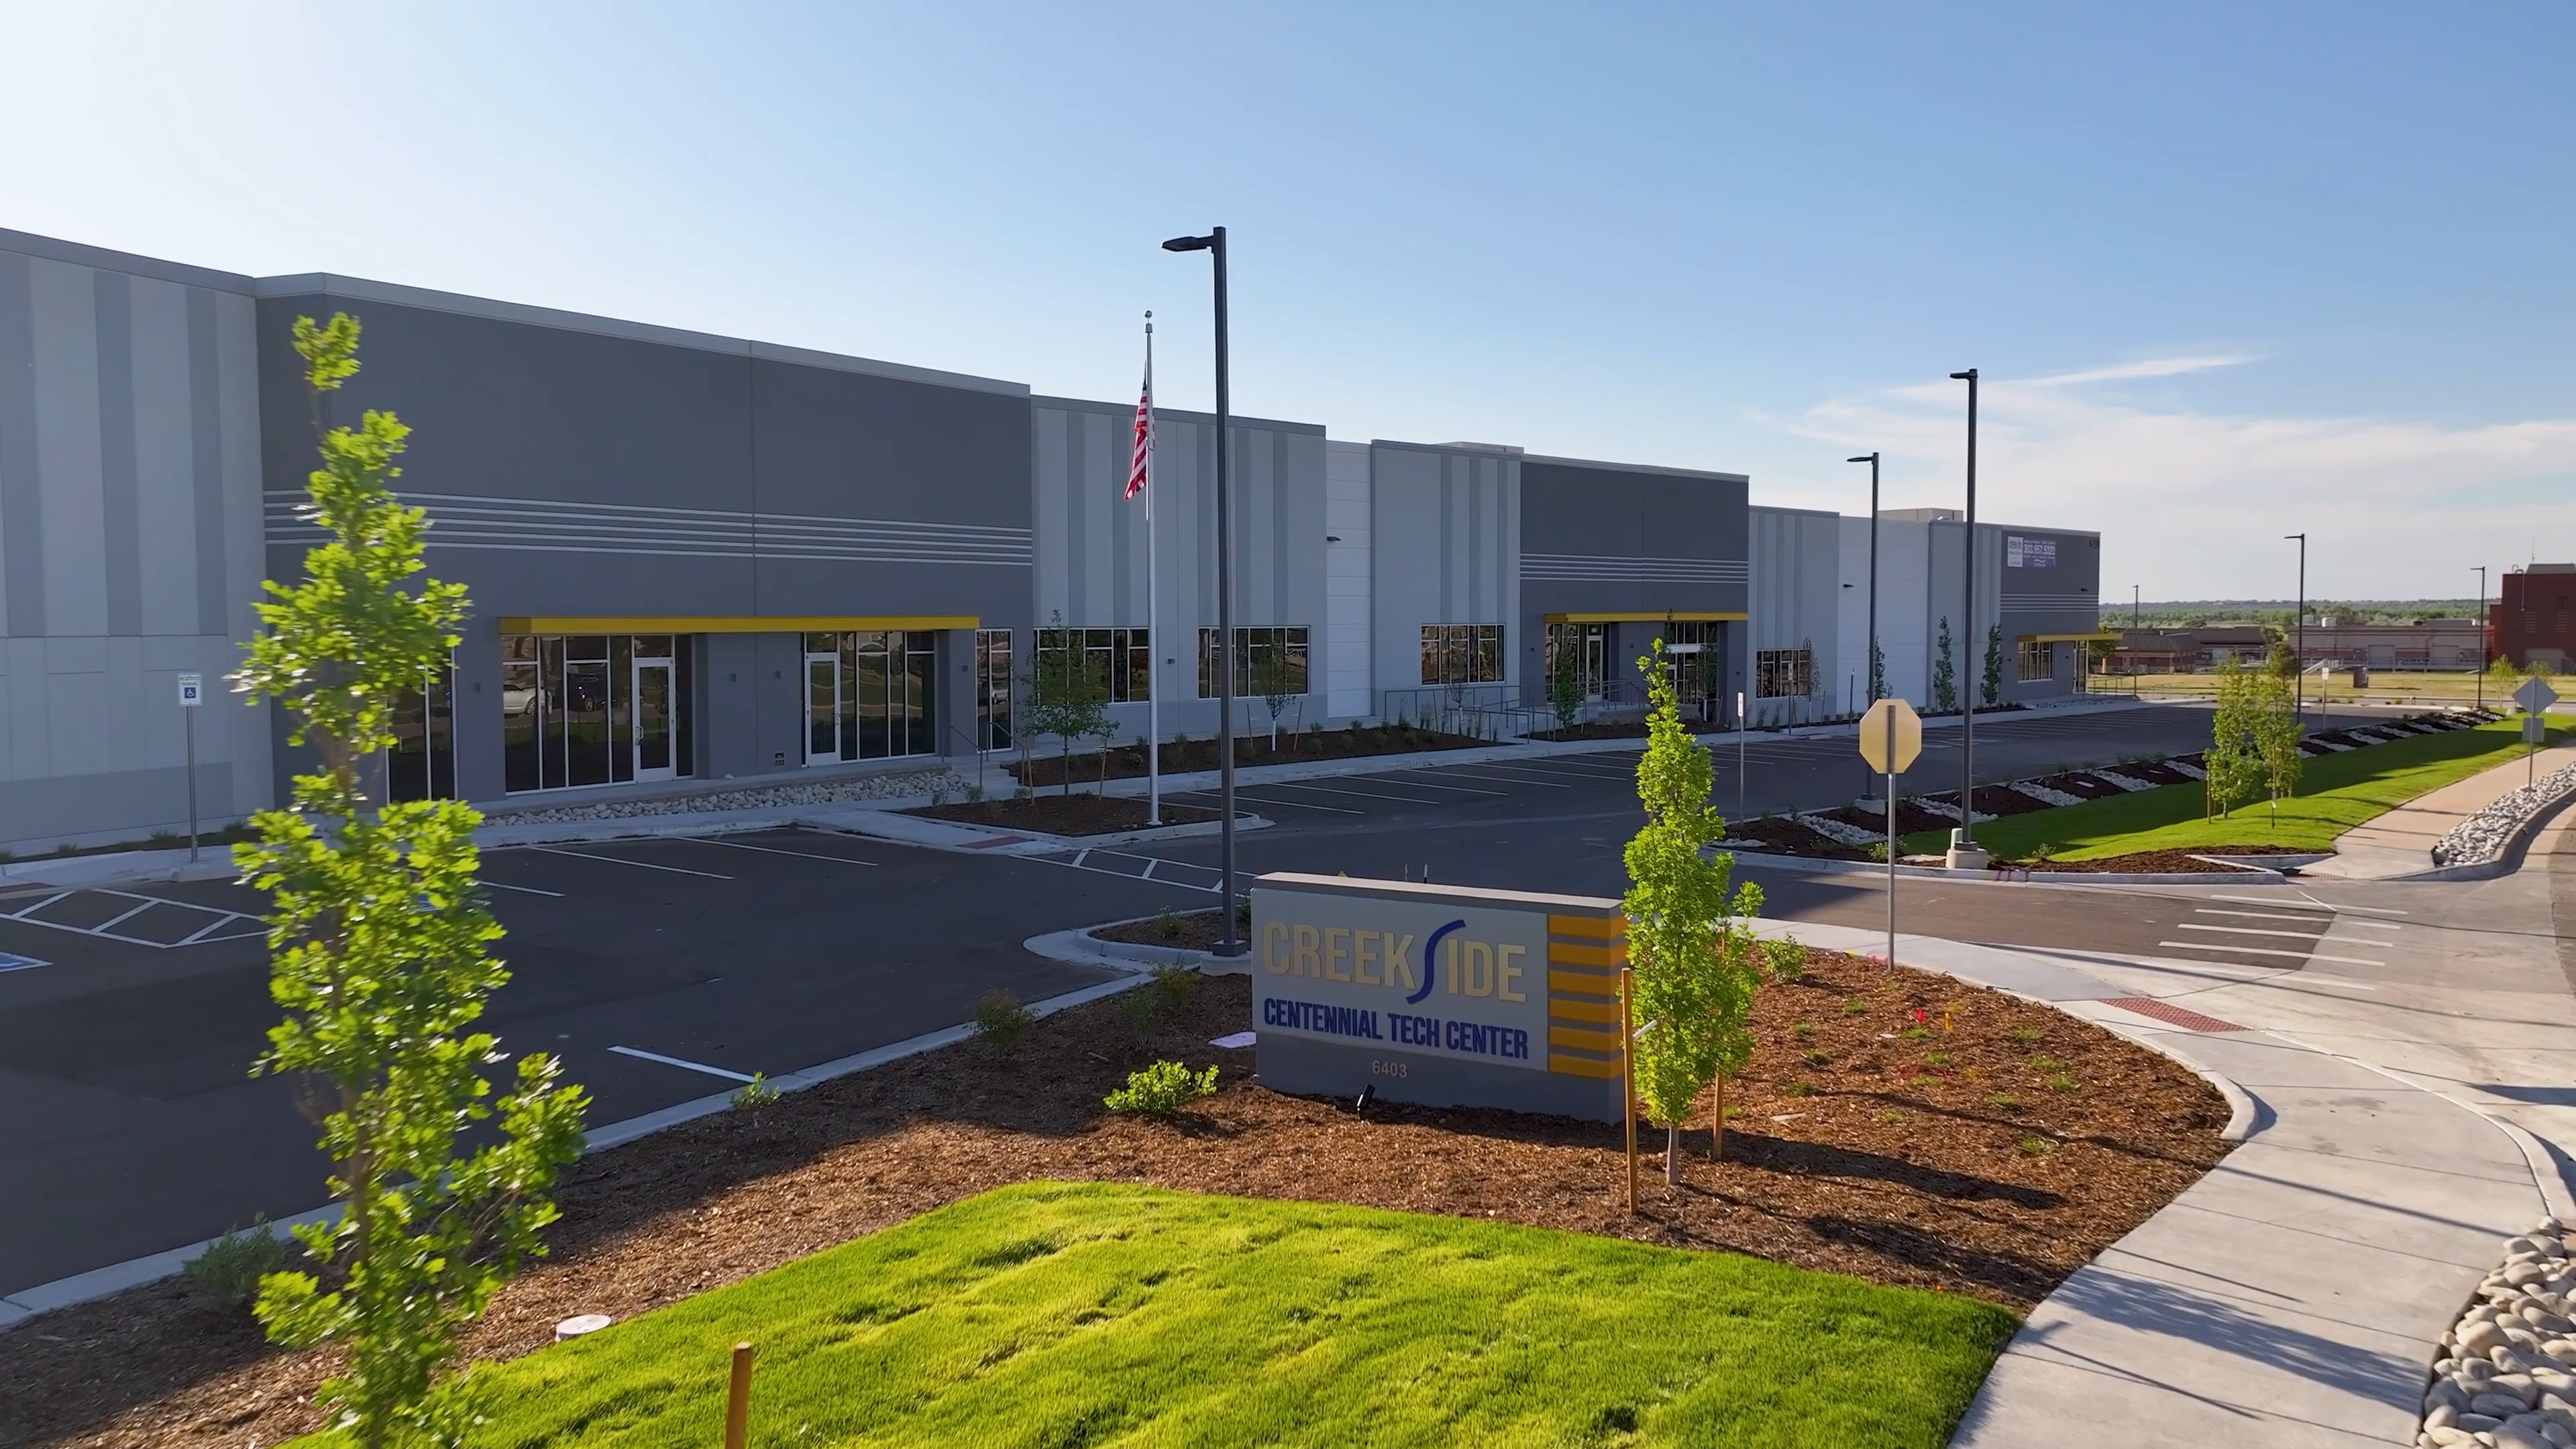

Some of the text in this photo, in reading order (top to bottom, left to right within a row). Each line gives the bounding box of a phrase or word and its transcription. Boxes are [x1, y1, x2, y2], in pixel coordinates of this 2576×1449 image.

[1264, 919, 1527, 1004] CREEKSIDE
[1265, 998, 1528, 1059] CENTENNIAL TECH CENTER
[1372, 1061, 1407, 1078] 6403
